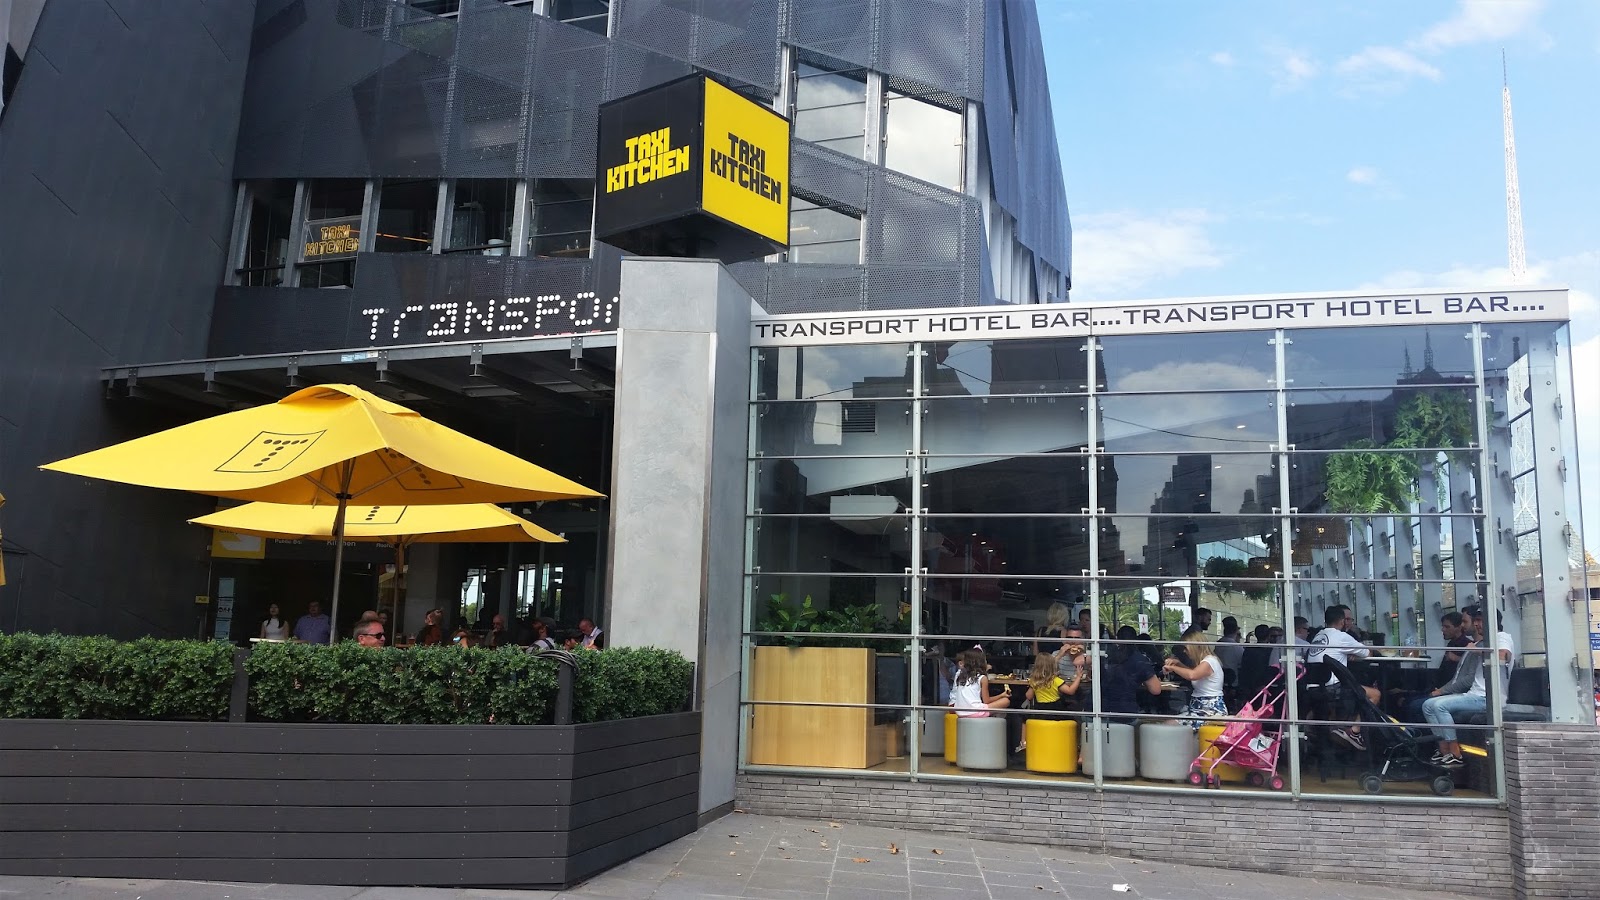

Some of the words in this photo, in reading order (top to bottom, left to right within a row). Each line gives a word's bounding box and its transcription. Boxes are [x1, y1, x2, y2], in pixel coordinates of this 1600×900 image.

[625, 127, 670, 162] TAXI
[728, 132, 766, 173] TAXI
[606, 145, 690, 194] KITCHEN
[710, 148, 782, 204] KITCHEN
[320, 224, 351, 240] TAXI
[755, 318, 920, 338] TRANSPORT
[929, 315, 1021, 333] HOTEL
[1326, 299, 1432, 318] HOTEL
